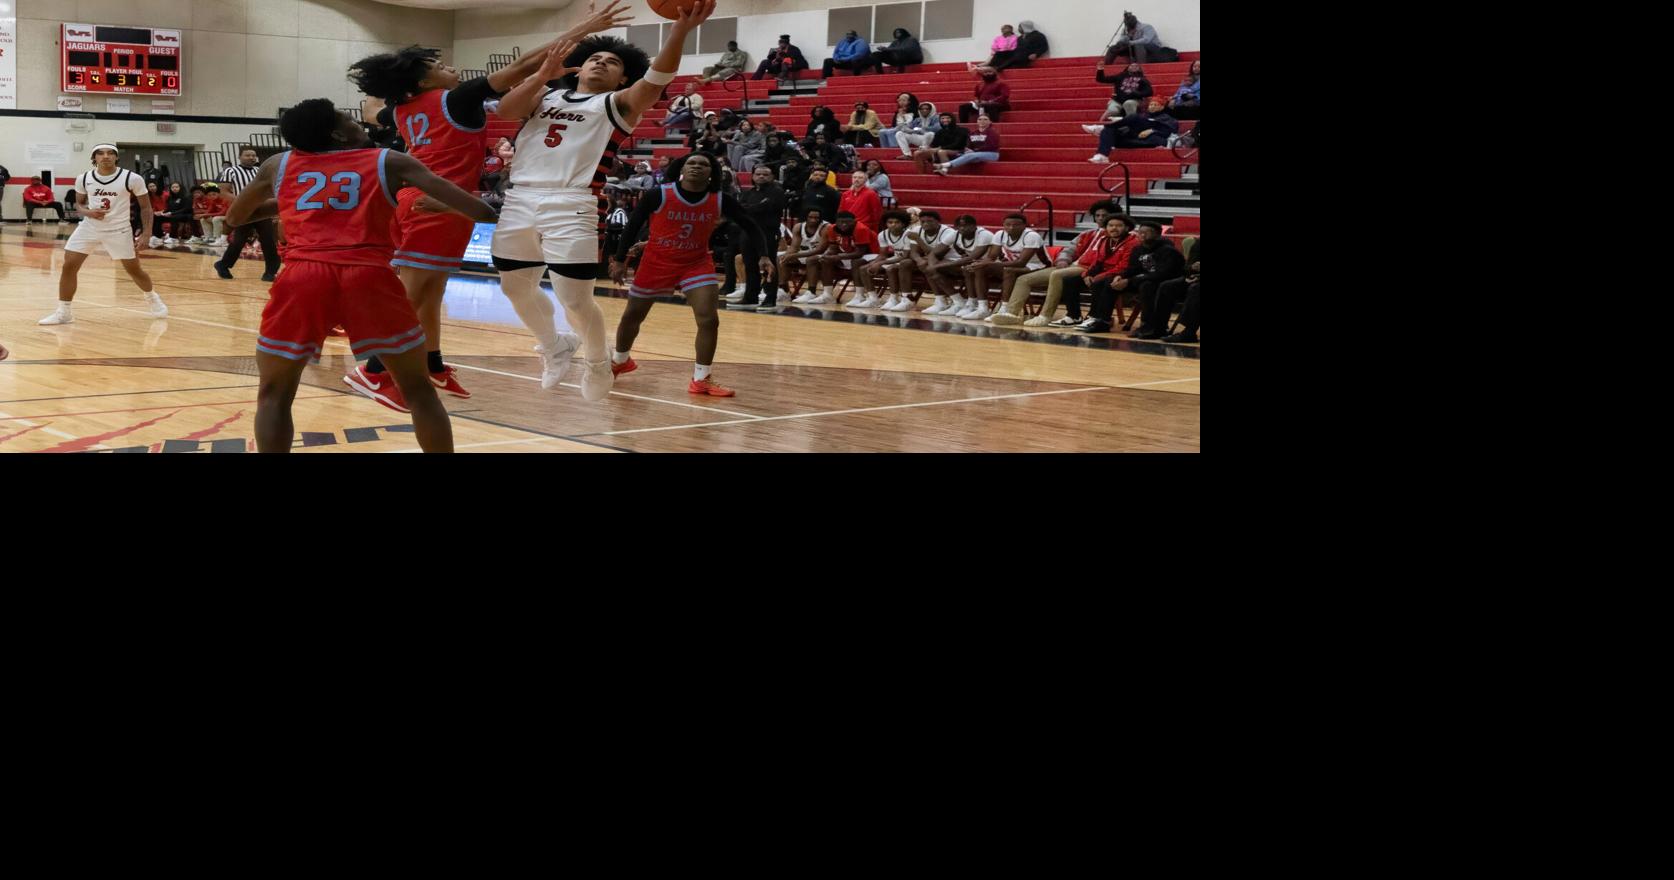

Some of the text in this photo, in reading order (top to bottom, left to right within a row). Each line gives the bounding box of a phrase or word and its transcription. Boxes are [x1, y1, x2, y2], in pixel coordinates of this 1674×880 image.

[66, 42, 106, 51] JAGUARS
[148, 46, 176, 55] GUEST
[105, 67, 127, 75] PLAYER
[75, 72, 84, 84] 3
[91, 75, 100, 84] 4
[148, 77, 156, 87] 2
[167, 76, 176, 88] 0
[67, 84, 87, 92] SCORE
[540, 106, 586, 123] Horn
[406, 112, 431, 146] 12
[543, 124, 567, 148] 5
[94, 188, 119, 197] Horn
[296, 171, 362, 211] 23
[100, 197, 111, 211] 3
[667, 210, 713, 222] DALLAS
[678, 223, 694, 239] 3
